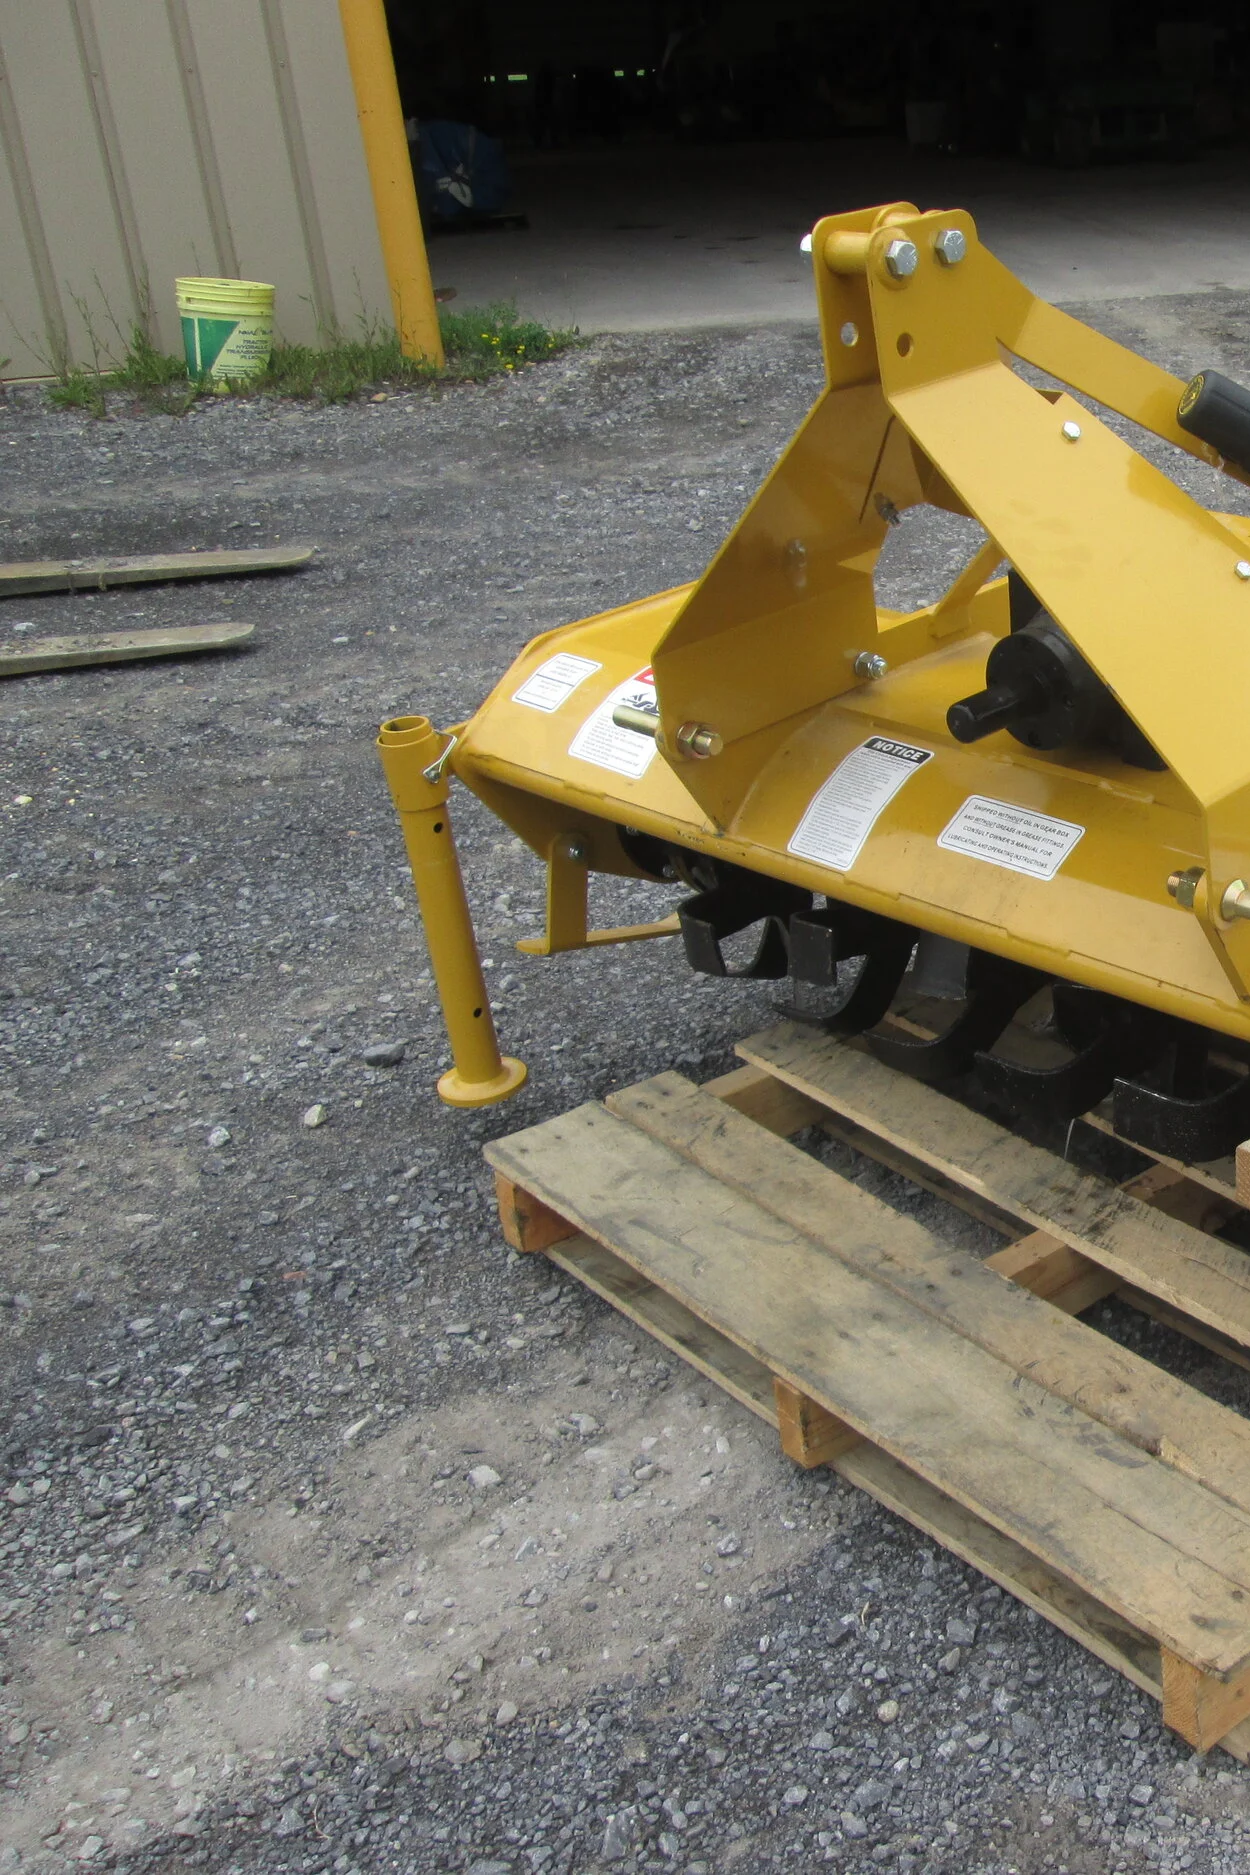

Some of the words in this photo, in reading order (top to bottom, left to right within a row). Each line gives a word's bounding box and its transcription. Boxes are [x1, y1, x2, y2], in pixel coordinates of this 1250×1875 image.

[872, 741, 924, 760] NOTICE
[973, 804, 998, 816] SHIPPED
[997, 811, 1024, 824] WITHOUT
[1023, 819, 1033, 827] OIL
[1040, 824, 1056, 834] GEAR
[974, 817, 997, 829] WITHOUT
[996, 823, 1016, 833] GREASE
[1021, 831, 1042, 842] GREASE
[948, 834, 978, 847] LUBRICATING
[987, 845, 1014, 858] OPERATING
[963, 825, 989, 837] CONSULT
[989, 833, 1015, 845] OWNER'S
[1015, 841, 1039, 853] MANUAL
